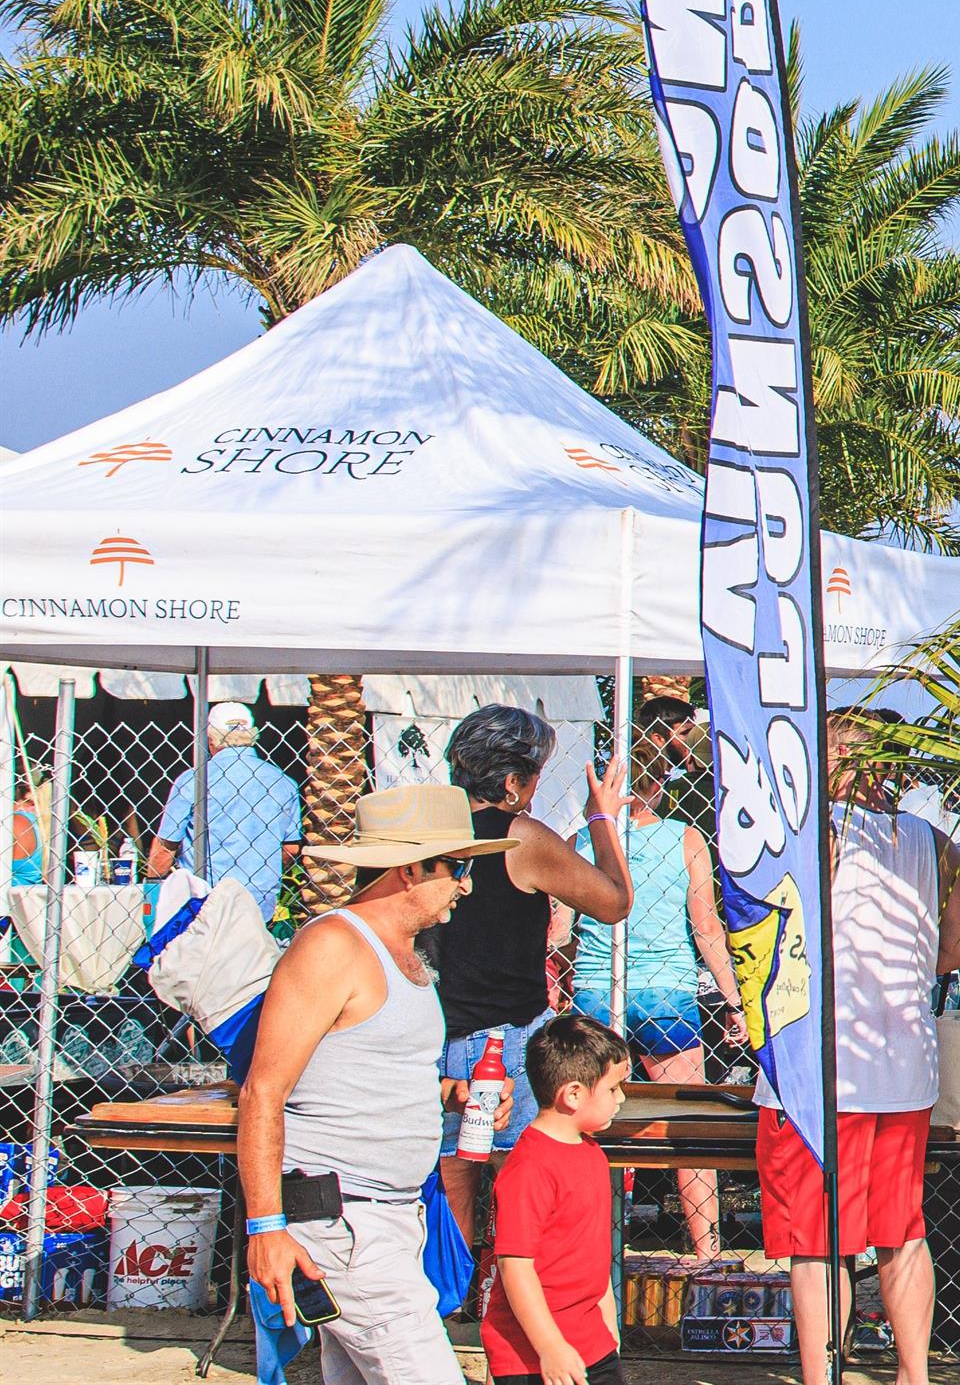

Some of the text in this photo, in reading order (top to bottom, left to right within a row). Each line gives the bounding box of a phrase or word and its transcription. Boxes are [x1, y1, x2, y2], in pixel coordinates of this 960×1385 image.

[213, 427, 436, 447] CINNAMON
[180, 447, 415, 481] SHORE
[2, 598, 241, 624] CINNAMON SHORE
[854, 626, 887, 650] SHORE
[114, 1239, 199, 1277] ACE
[126, 1276, 160, 1286] helpful
